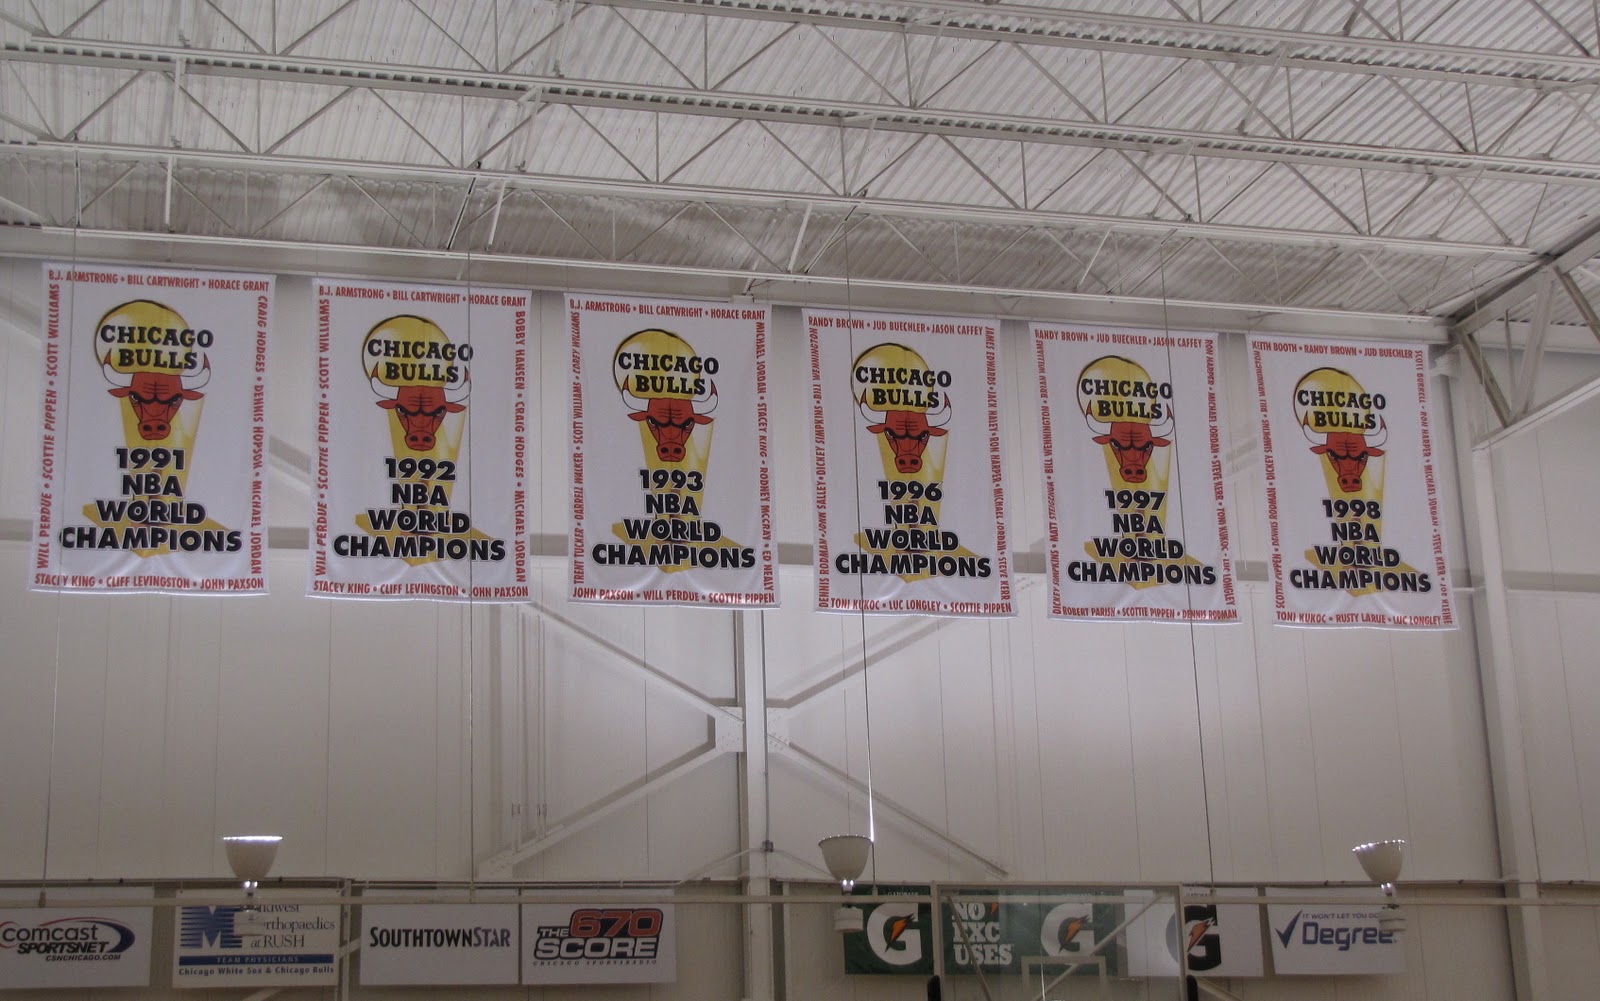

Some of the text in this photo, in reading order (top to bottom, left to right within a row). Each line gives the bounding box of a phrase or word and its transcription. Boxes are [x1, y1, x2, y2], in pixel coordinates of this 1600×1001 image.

[49, 270, 269, 292] B.J. ARMSTRONG BILL CARTWRIGHT HORACE GRANT
[319, 286, 526, 306] B.J. ARMSTRONG BILL CARTWRIGHT HORACE GRANT
[585, 301, 630, 313] ARMSTRONG
[639, 305, 653, 314] BILL
[656, 306, 703, 317] CARTWRIGHT
[711, 309, 739, 319] HORACE
[742, 310, 765, 320] GRANT
[101, 325, 214, 347] CHICAGO
[809, 316, 983, 335] RANDY BROWN JUD BUECHLER JASON CAFFEY
[1035, 330, 1201, 348] RANDY BROWN JUD BUECHLER JASON CAFFEY
[119, 349, 197, 369] BULLS
[368, 339, 473, 361] CHICAGO
[1274, 343, 1413, 358] BOOTH RANDY BROWN JUD BUECHLER
[386, 362, 458, 382] BULLS
[619, 352, 719, 374] CHICAGO
[636, 375, 705, 395] BULLS
[856, 366, 951, 387] CHICAGO
[873, 389, 939, 408] BULLS
[1082, 379, 1172, 399] CHICAGO
[1297, 390, 1385, 409] CHICAGO
[1098, 400, 1162, 419] BULLS
[1313, 411, 1376, 429] BULLS
[37, 284, 59, 569] WILL PERDUE SCOTTIE PIPPEN SCOTT WILLIAMS
[251, 295, 267, 574] CRAIG HODGES DENNIS HOPSON MICHAEL JORDAN
[116, 448, 184, 470] 1991
[386, 458, 455, 480] 1992
[123, 474, 182, 497] NBA
[640, 470, 703, 491] 1993
[878, 481, 942, 500] 1996
[392, 484, 448, 506] NBA
[646, 494, 699, 516] NBA
[1105, 490, 1165, 510] 1997
[96, 500, 206, 524] WORLD
[885, 505, 937, 526] NBA
[1323, 500, 1380, 519] 1998
[368, 510, 469, 532] WORLD
[624, 519, 721, 541] WORLD
[1113, 514, 1163, 533] NBA
[59, 527, 242, 551] CHAMPIONS
[865, 529, 958, 550] WORLD
[1331, 522, 1379, 542] NBA
[334, 535, 505, 560] CHAMPIONS
[593, 544, 755, 568] CHAMPIONS
[1093, 538, 1183, 559] WORLD
[1315, 546, 1399, 567] WORLD
[836, 554, 991, 577] CHAMPIONS
[1068, 562, 1216, 585] CHAMPIONS
[72, 576, 263, 589] KING CLIFF LEVINGSTON JOHN PAXSON
[314, 581, 528, 597] STACEY KING CLIFF LEVINGSTON PAXSON
[1290, 570, 1431, 592] CHAMPIONS
[573, 588, 775, 603] JOHN PAXSON WILL PERDUE SCOTTIE PIPPEN
[831, 598, 1011, 613] TONI KUKOC LUC LONGLEY SCOTTIE PIPPEN
[1062, 607, 1237, 619] ROBERT PARISH SCOTTIE PIPPEN DENNIS RODMAN
[1276, 611, 1441, 625] TONI KUKOC RUSTY LARUE LUC LONGLEY
[952, 902, 985, 920] NO
[264, 916, 335, 932] rthopaedics
[540, 909, 662, 937] THE 670
[952, 922, 1000, 942] EXC
[1041, 903, 1094, 956] G
[251, 935, 305, 948] at RUSH
[867, 903, 922, 965] G
[1166, 905, 1221, 971] G
[1302, 922, 1393, 950] Degree
[18, 942, 109, 954] SPORTSNET
[535, 938, 657, 958] SCORE
[953, 944, 1012, 965] USES
[179, 968, 214, 976] Chicago
[275, 967, 309, 975] Chicago
